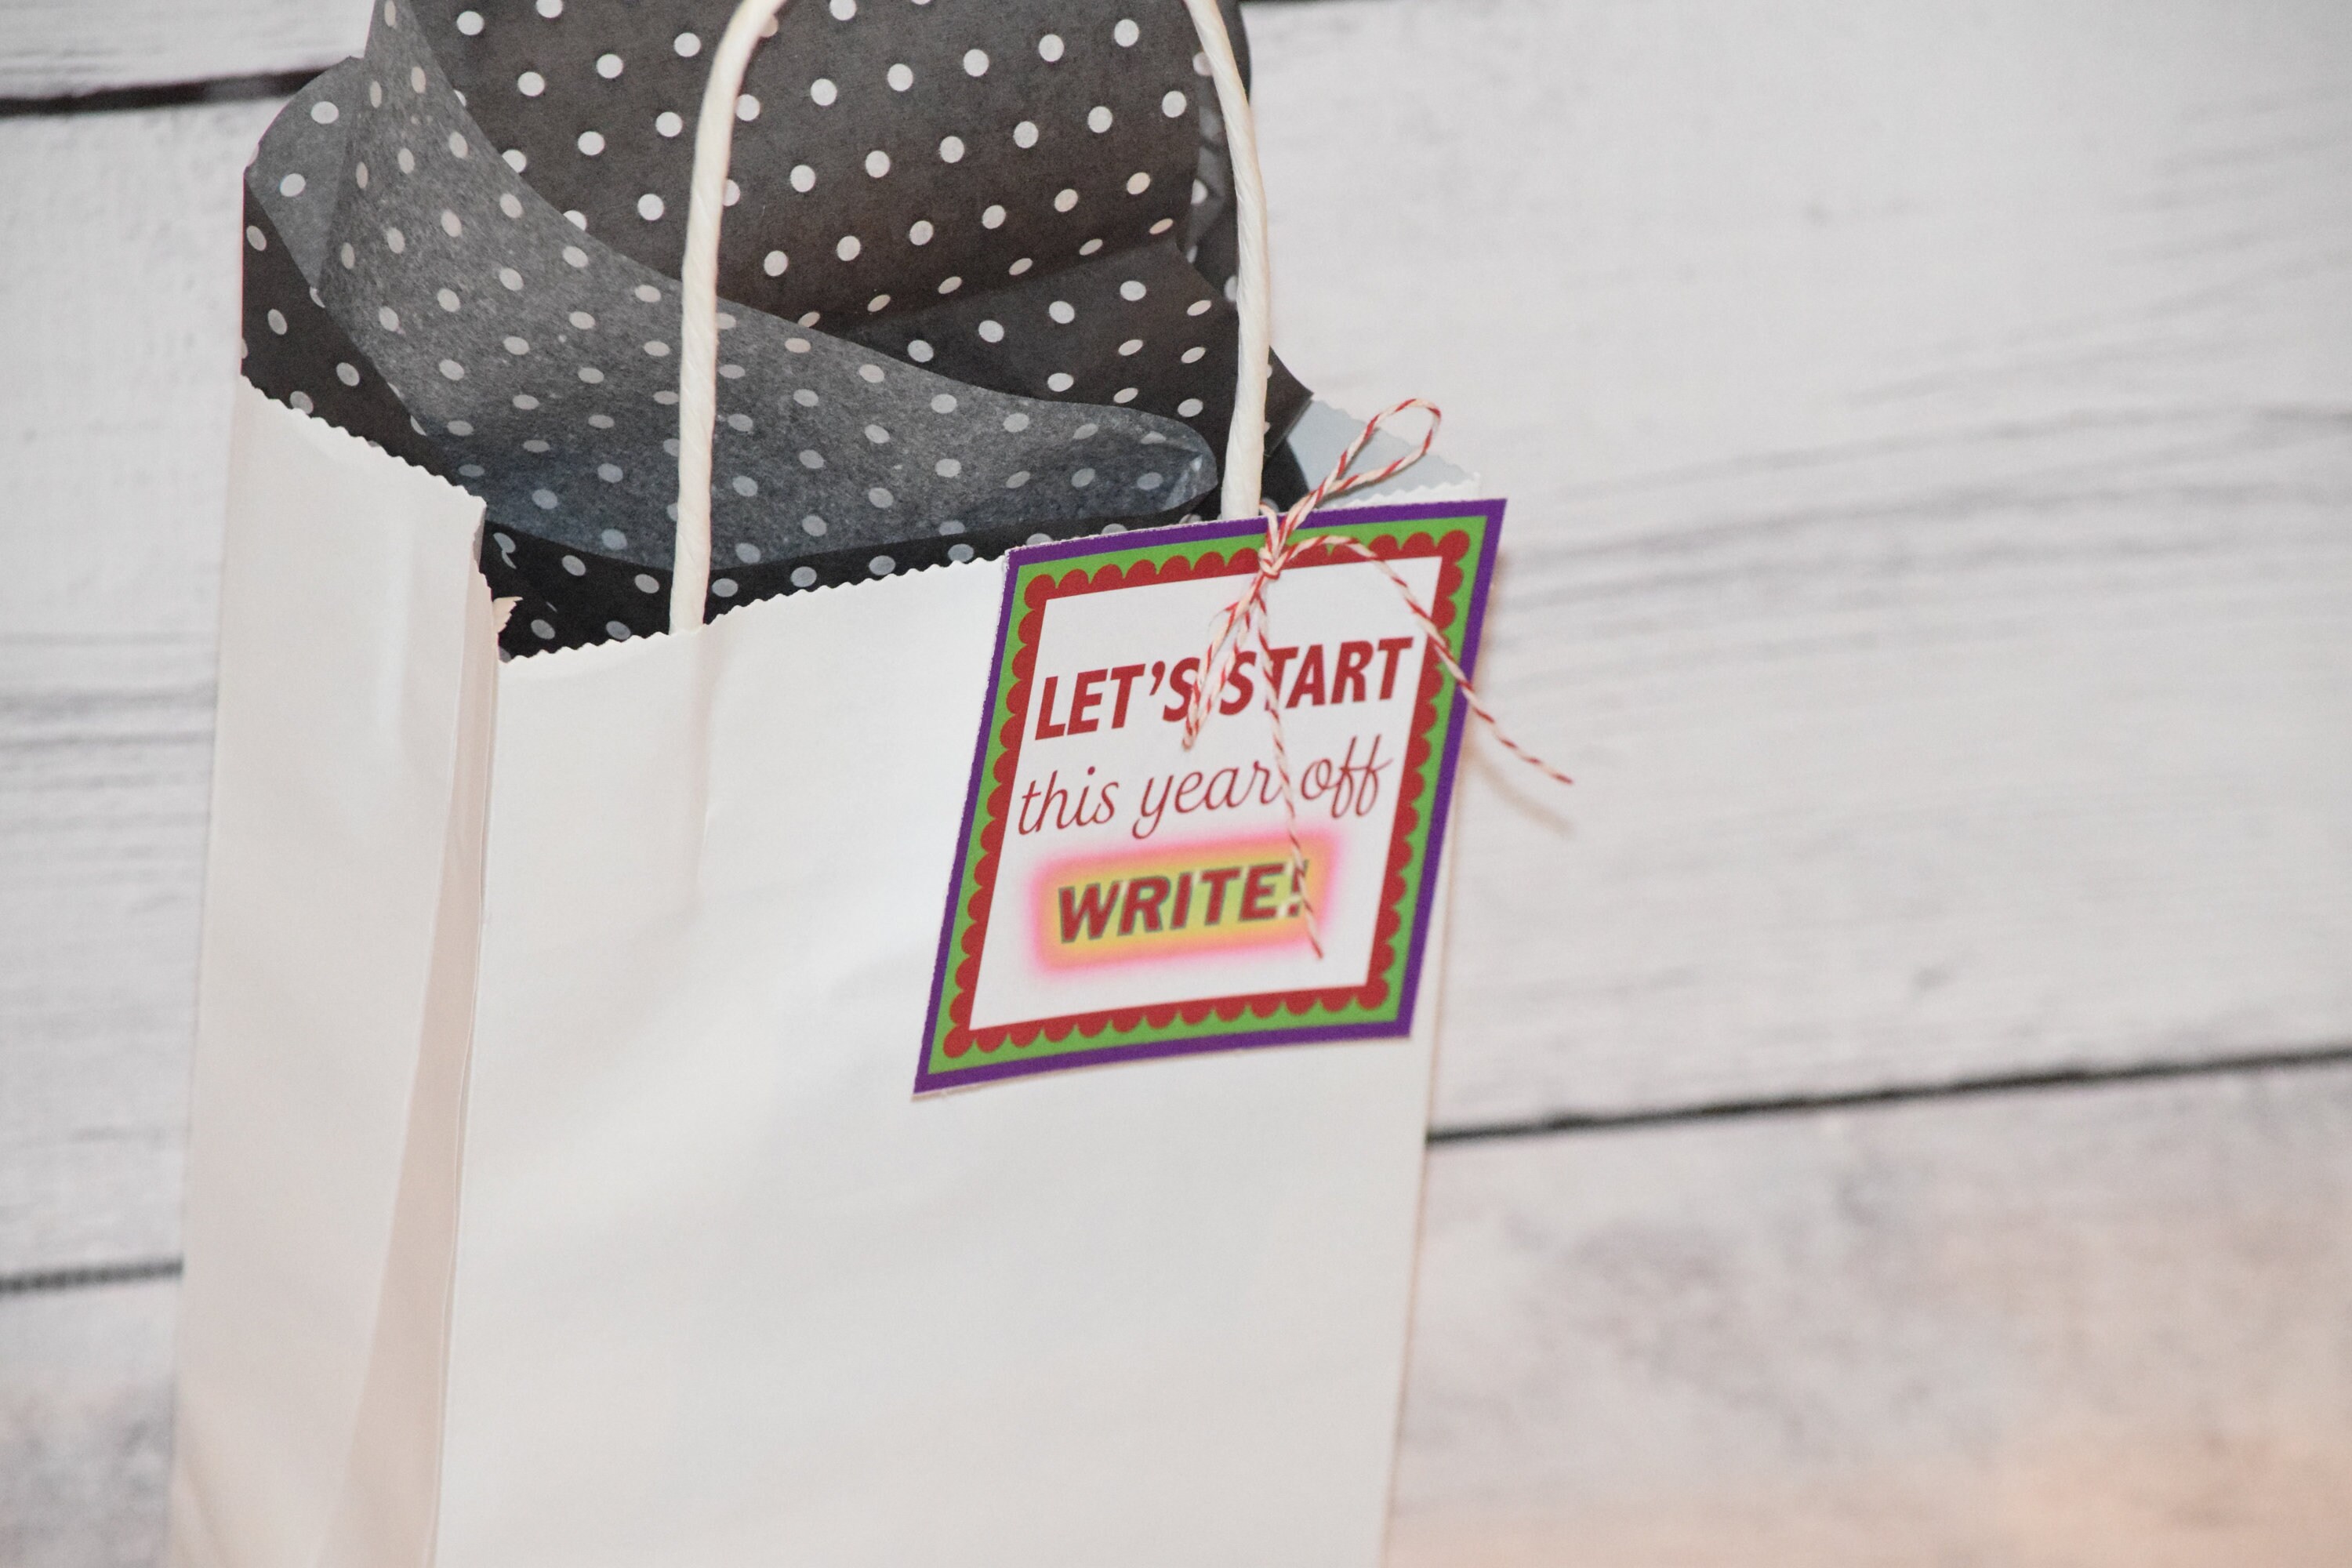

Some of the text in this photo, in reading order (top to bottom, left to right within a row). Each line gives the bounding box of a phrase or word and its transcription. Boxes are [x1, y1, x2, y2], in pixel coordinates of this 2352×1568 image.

[1034, 636, 1414, 741] LET'S START
[1017, 735, 1393, 839] this year off
[1058, 859, 1308, 944] WRITE!
